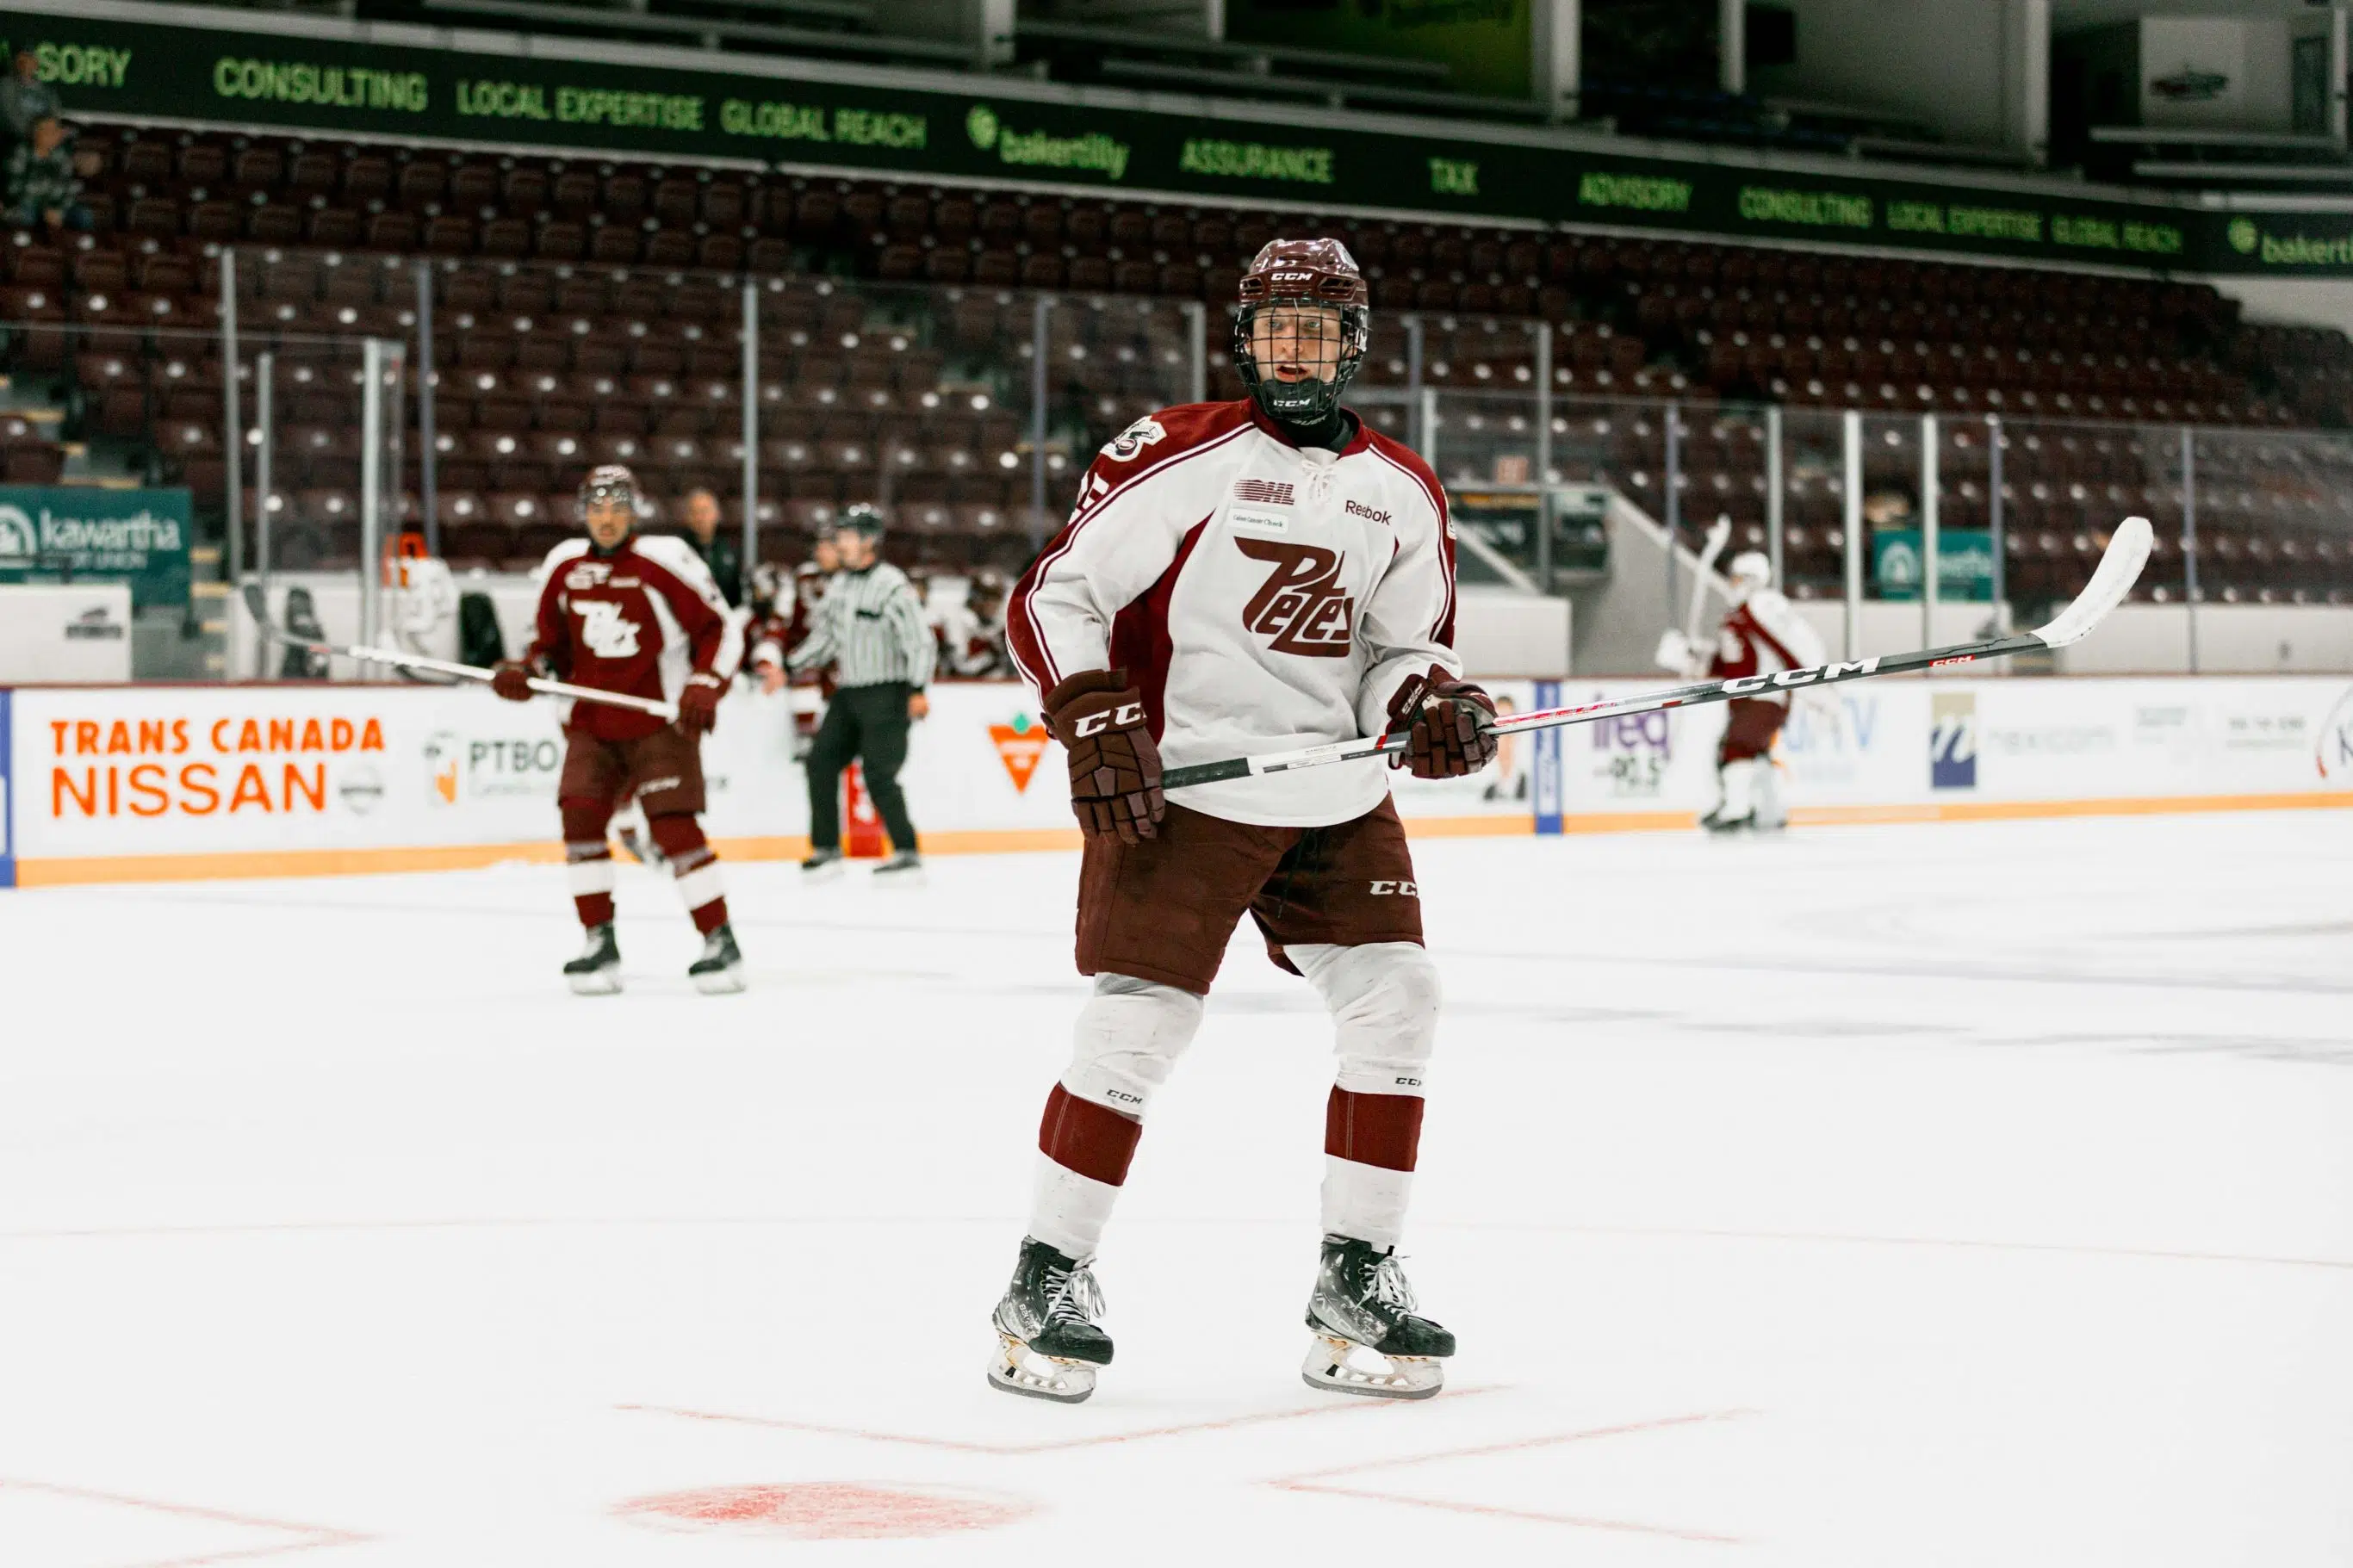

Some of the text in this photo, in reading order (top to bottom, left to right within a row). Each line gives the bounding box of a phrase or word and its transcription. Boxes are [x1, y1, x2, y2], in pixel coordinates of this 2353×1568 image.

[33, 42, 133, 87] SORY
[214, 56, 428, 112] CONSULTING
[456, 80, 705, 131] LOCAL EXPERTISE
[720, 99, 927, 150] GLOBAL REACH
[1179, 138, 1334, 183] ASSURANCE
[1429, 158, 1478, 195] TAX
[1578, 172, 1692, 211] ADVISORY
[1739, 185, 1873, 228] CONSULTING
[1271, 272, 1313, 282] CCM
[1273, 398, 1311, 407] CCM
[40, 509, 182, 551] kawartha
[1345, 499, 1392, 525] Reebok
[1233, 536, 1355, 658] Petes
[1721, 655, 1882, 694] CCM
[1932, 654, 1973, 666] CCM
[51, 716, 385, 756] TRANS CANADA
[1074, 701, 1147, 738] CC
[469, 740, 559, 772] PTBO
[52, 761, 326, 818] NISSAN
[1369, 880, 1417, 896] CC
[1107, 1088, 1143, 1104] CCM
